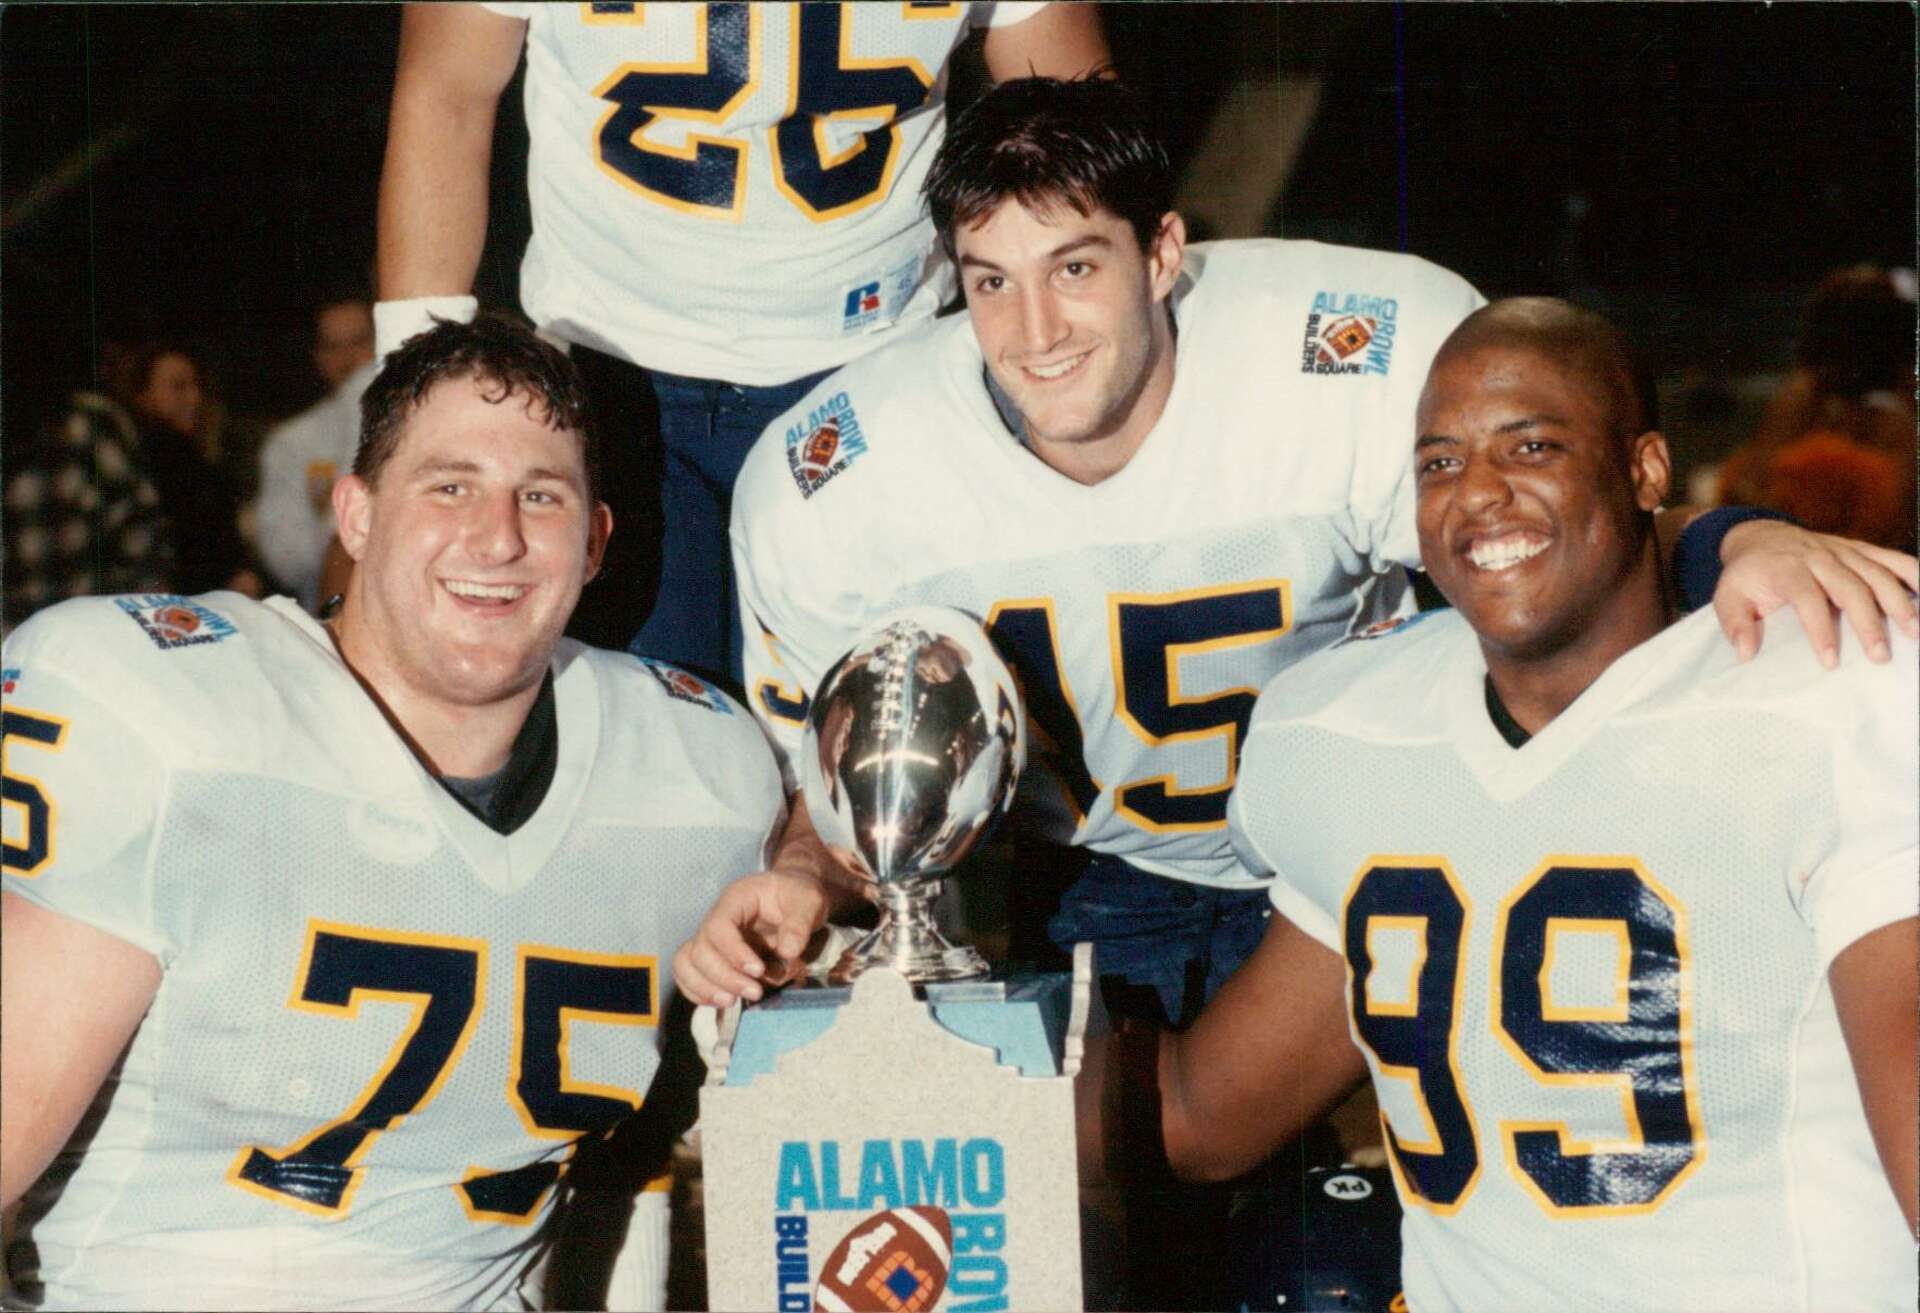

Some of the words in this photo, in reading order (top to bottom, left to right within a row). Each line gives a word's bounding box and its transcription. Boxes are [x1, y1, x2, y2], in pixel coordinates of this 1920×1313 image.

[592, 2, 937, 224] 26
[1311, 290, 1399, 321] ALAMO
[1360, 320, 1396, 376] BOWL
[786, 391, 850, 448] ALAMO
[224, 916, 659, 1227] 75
[1342, 853, 1707, 1221] 99
[774, 1136, 1005, 1212] ALAMO
